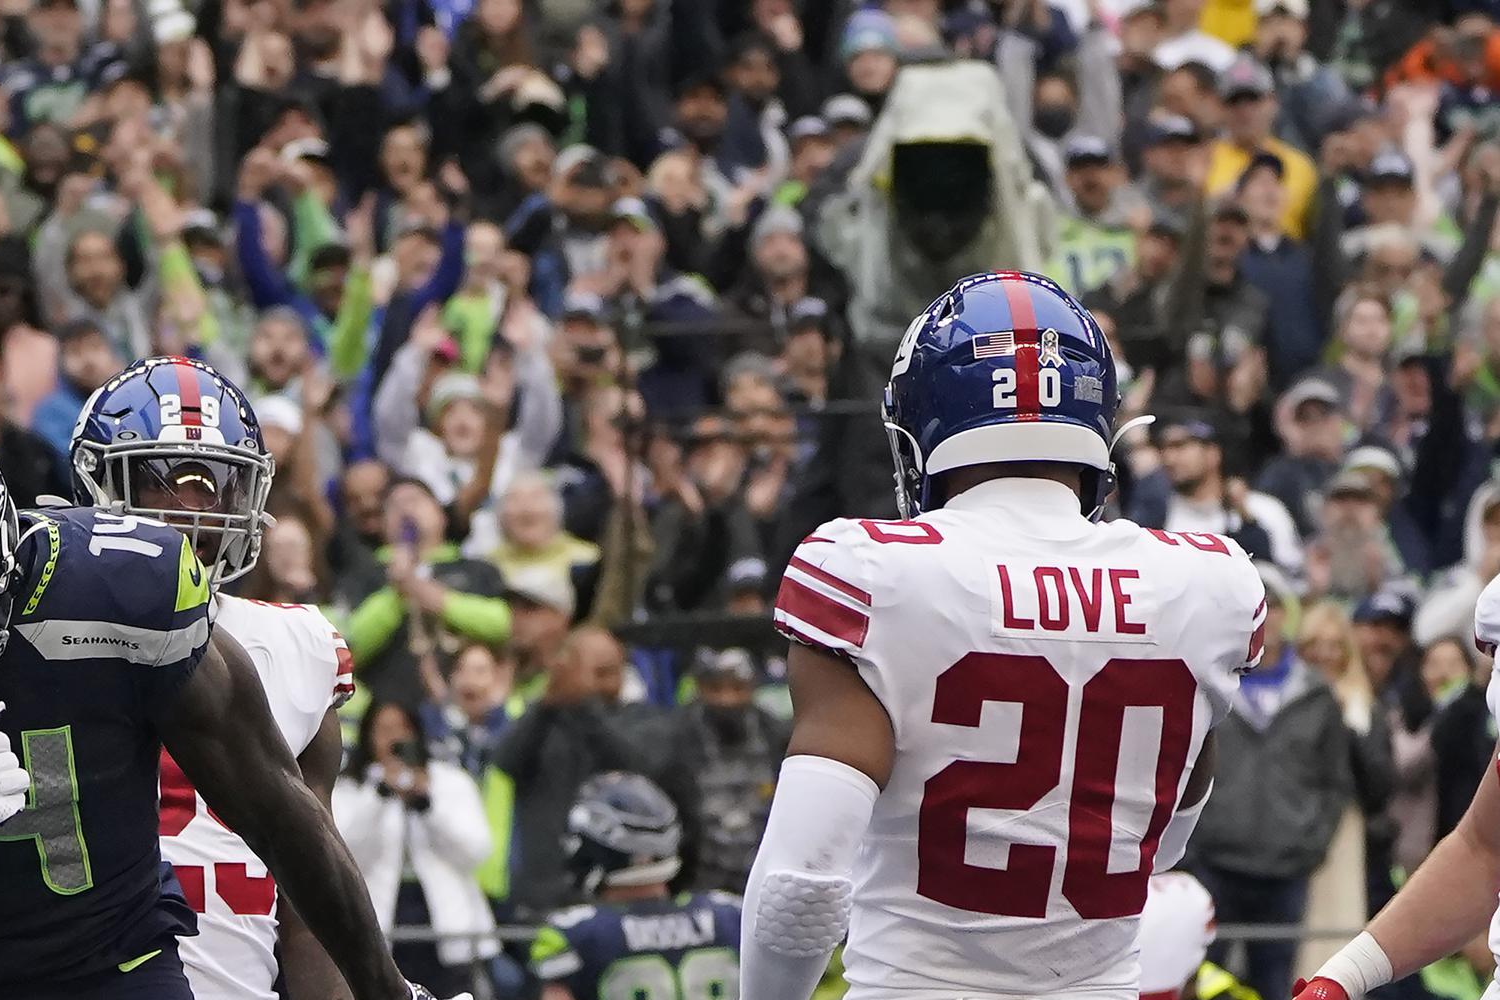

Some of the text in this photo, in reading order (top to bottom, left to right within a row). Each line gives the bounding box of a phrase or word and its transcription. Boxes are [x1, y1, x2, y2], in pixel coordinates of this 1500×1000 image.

[160, 394, 220, 427] 29
[991, 367, 1061, 408] 20
[88, 511, 168, 558] 14
[996, 564, 1146, 635] LOVE
[916, 651, 1197, 919] 20
